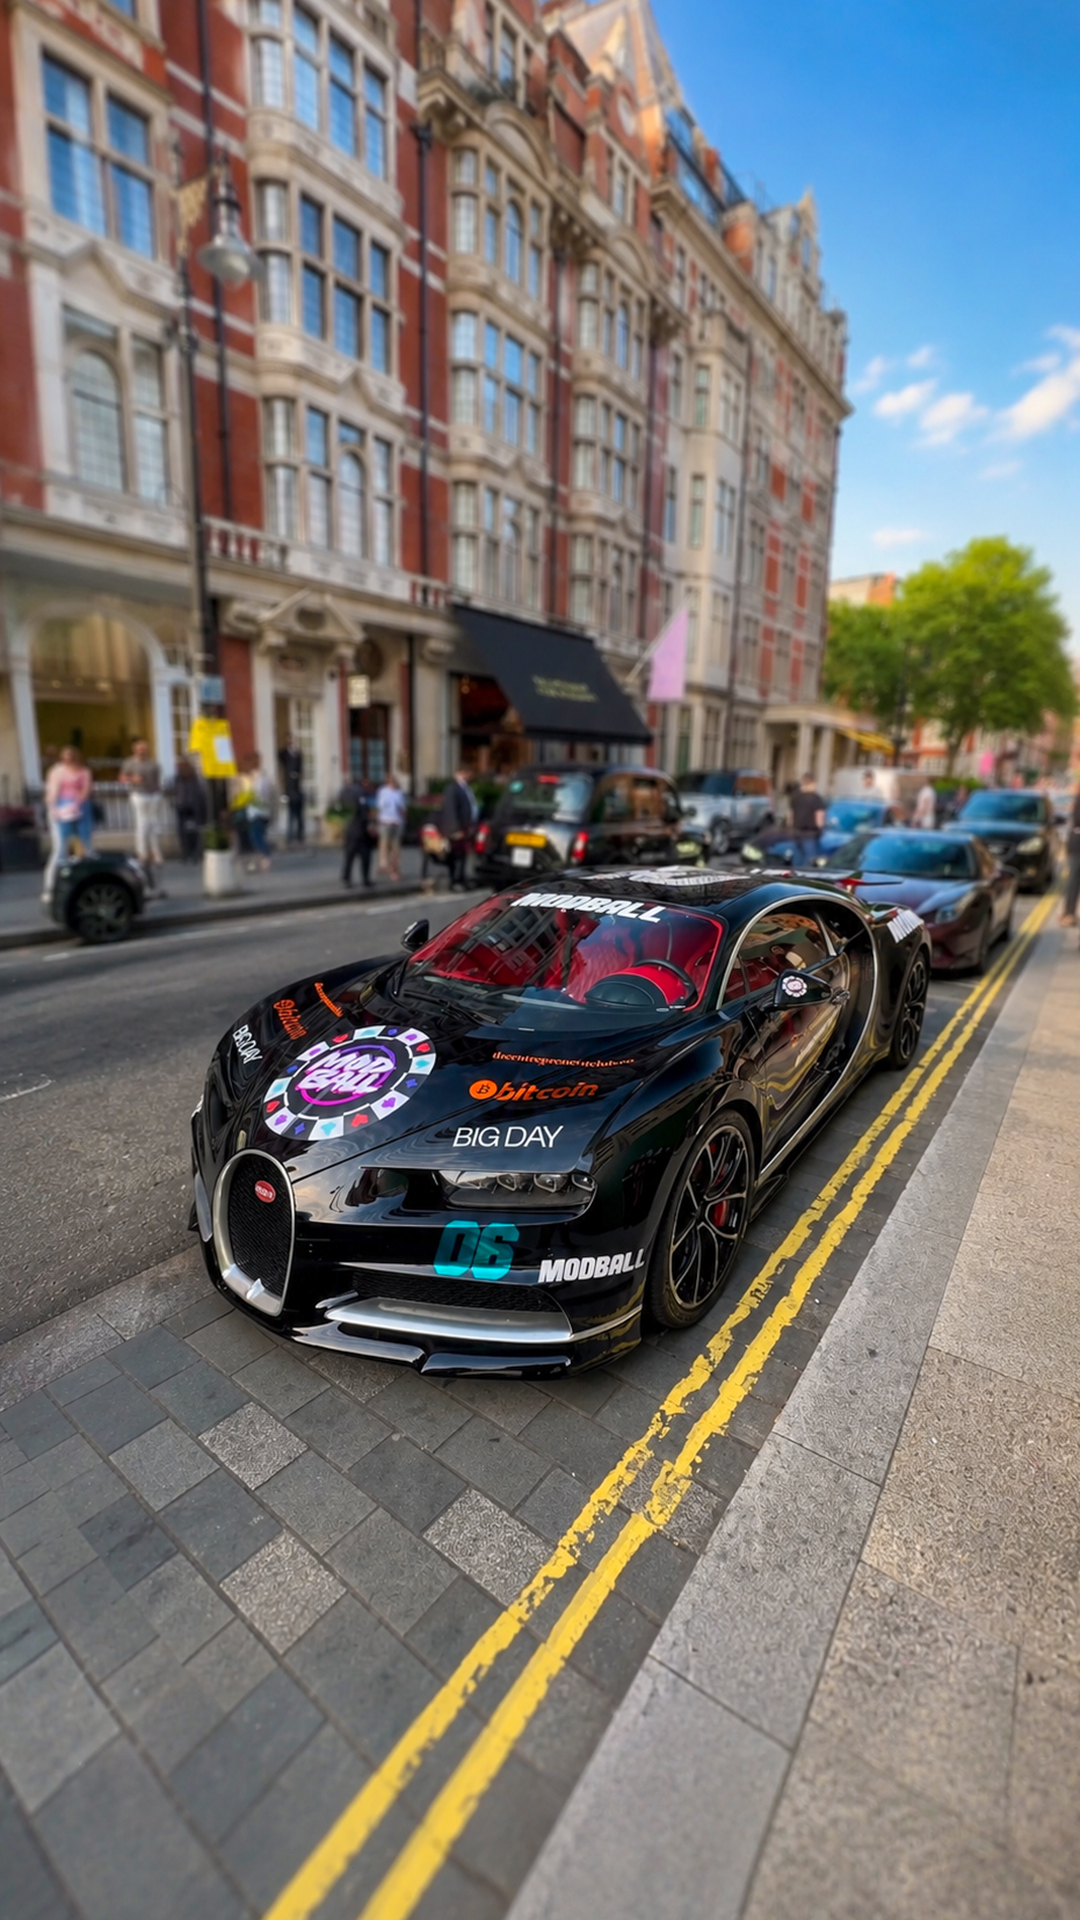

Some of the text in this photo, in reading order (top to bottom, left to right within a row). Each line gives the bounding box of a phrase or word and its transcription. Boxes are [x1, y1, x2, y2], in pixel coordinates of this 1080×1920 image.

[510, 892, 666, 923] MODBALL
[305, 1050, 396, 1075] MOD
[295, 1068, 382, 1096] BALL
[494, 1081, 599, 1101] bitcoin
[452, 1125, 564, 1148] BIG DAY
[433, 1220, 520, 1280] 06
[538, 1248, 645, 1283] MODBALL
